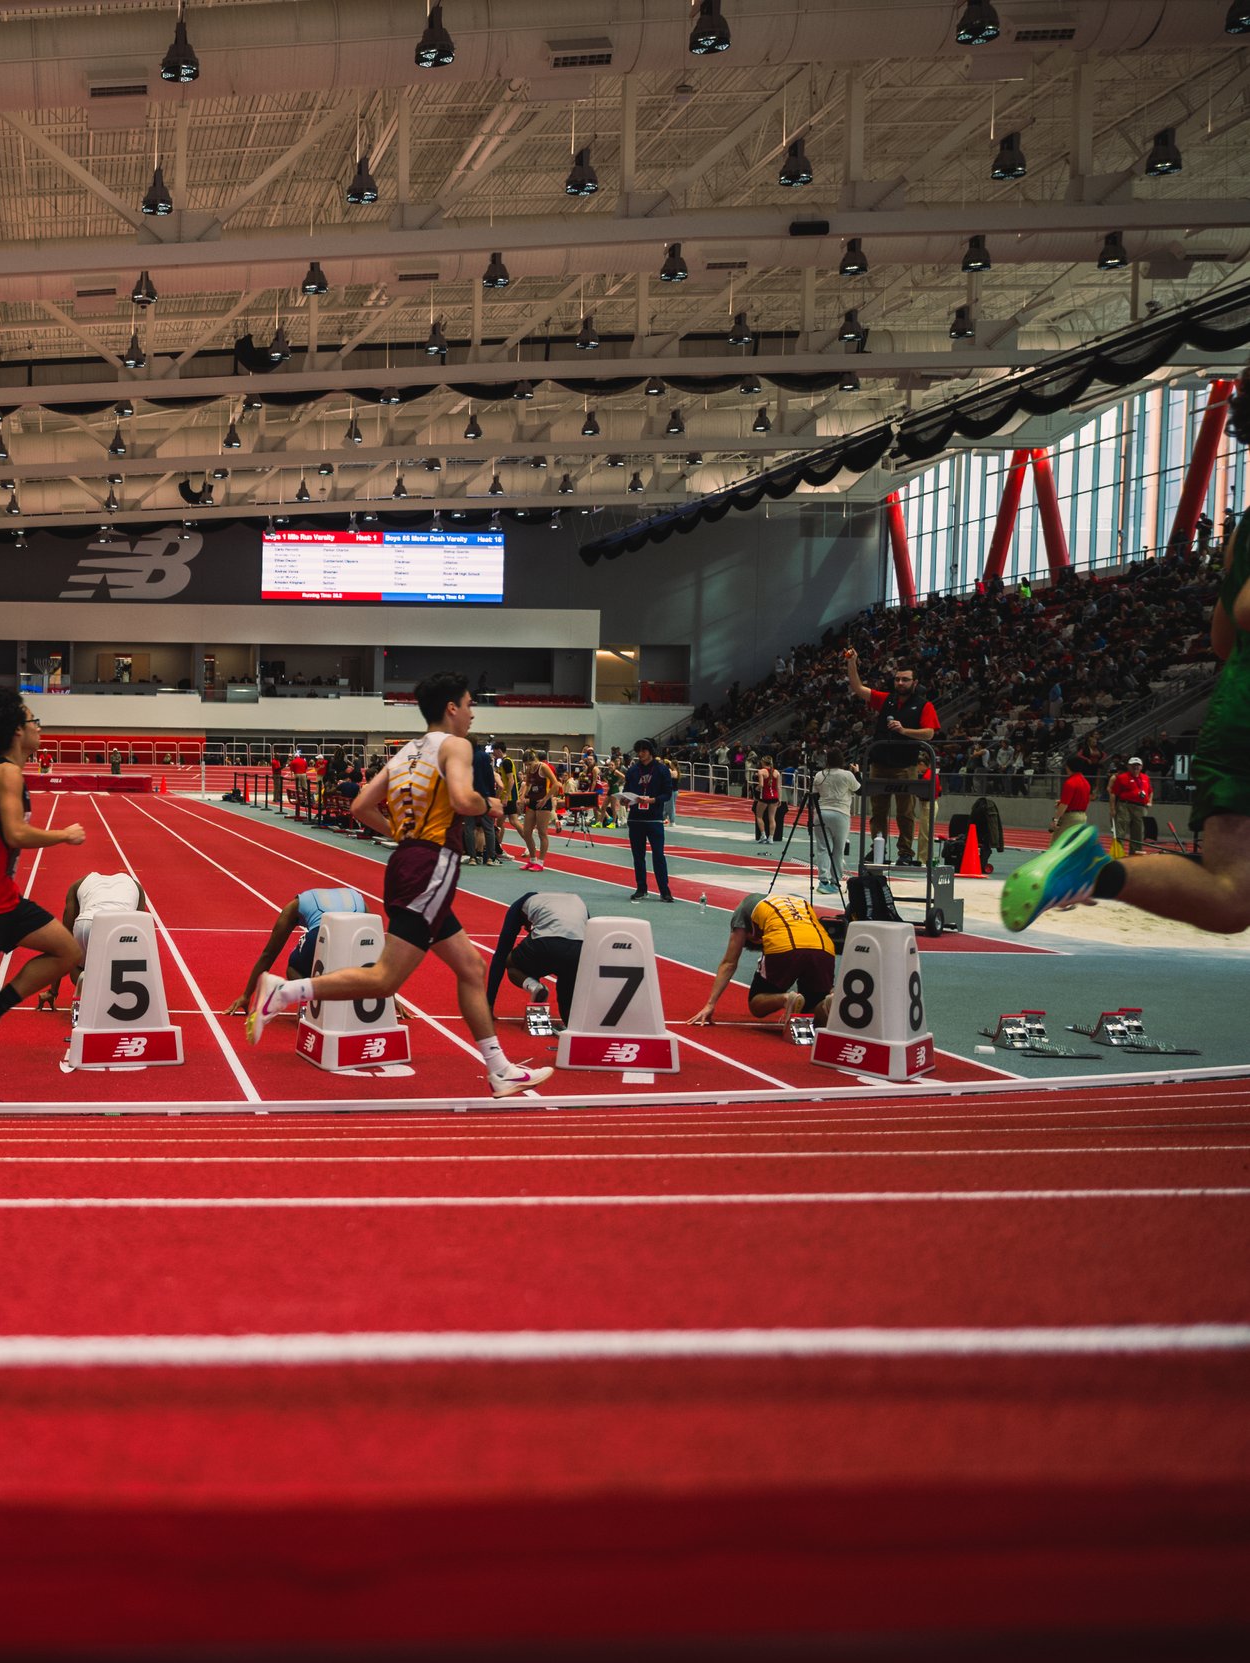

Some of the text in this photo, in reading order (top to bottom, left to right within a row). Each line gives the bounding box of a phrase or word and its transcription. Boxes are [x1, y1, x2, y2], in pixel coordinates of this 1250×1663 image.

[385, 535, 401, 543] Boys
[58, 527, 204, 600] NB
[884, 784, 910, 793] GILL
[855, 945, 870, 953] GILL
[107, 959, 150, 1021] 5
[599, 965, 644, 1027] 7
[839, 968, 874, 1029] 8
[909, 971, 923, 1032] 8
[112, 1037, 147, 1057] NB
[361, 1037, 386, 1059] NB
[601, 1043, 640, 1063] NB
[836, 1043, 867, 1064] NB
